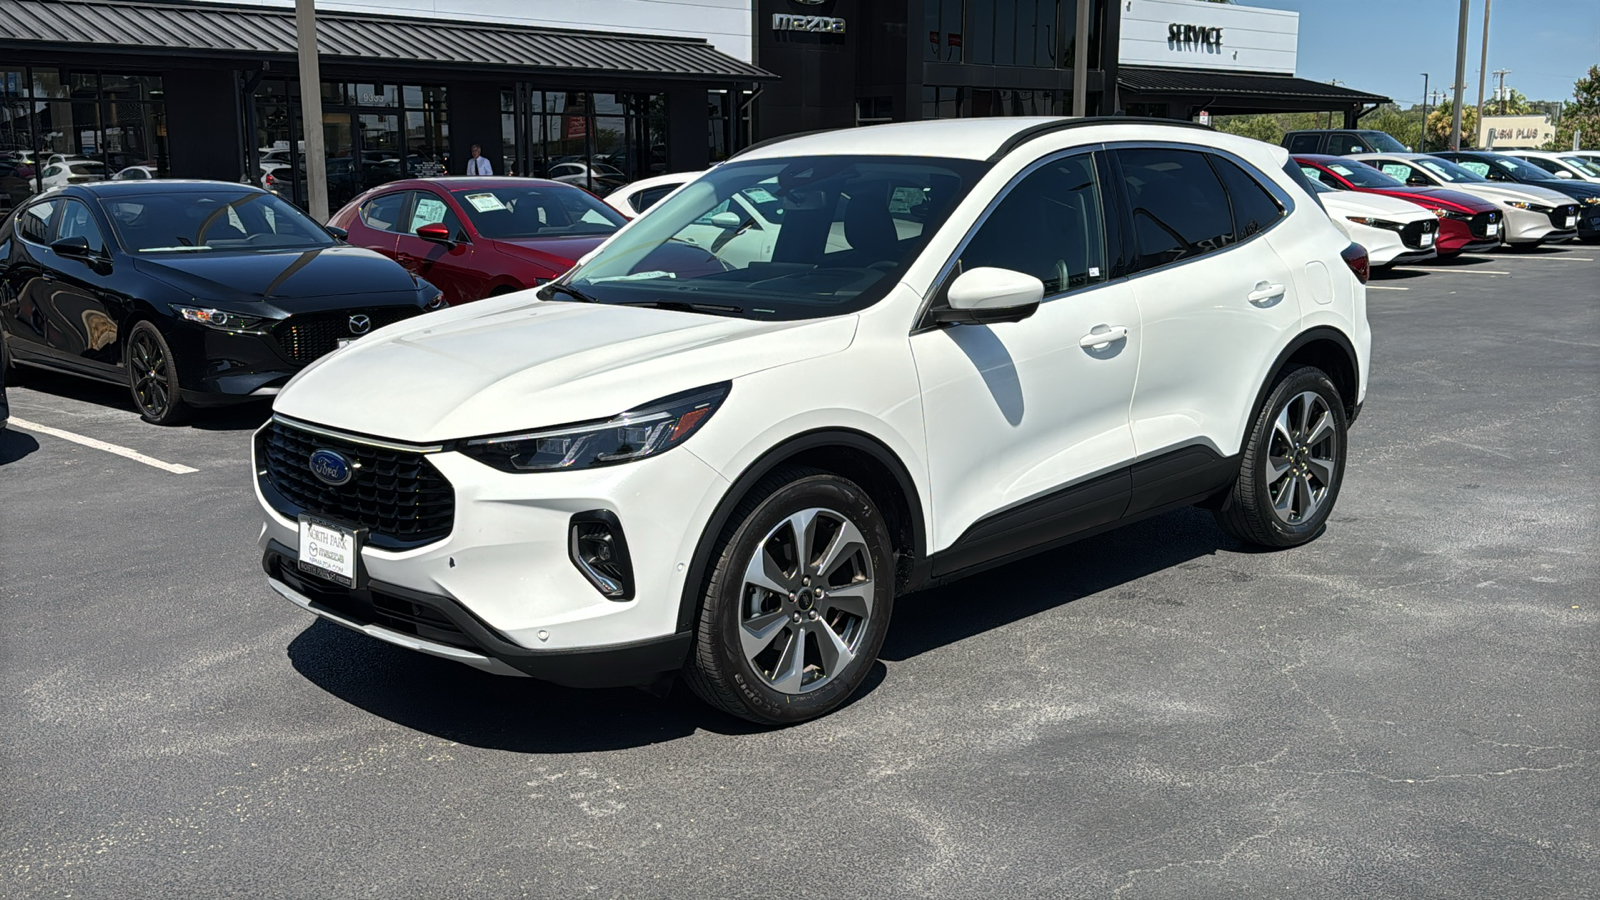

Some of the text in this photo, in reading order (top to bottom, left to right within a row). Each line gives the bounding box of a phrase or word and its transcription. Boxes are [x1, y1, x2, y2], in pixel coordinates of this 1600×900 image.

[1167, 22, 1224, 46] SERVICE
[1489, 127, 1539, 140] USHI PLUS
[315, 456, 339, 478] Ford
[307, 528, 347, 551] NORTH PARK
